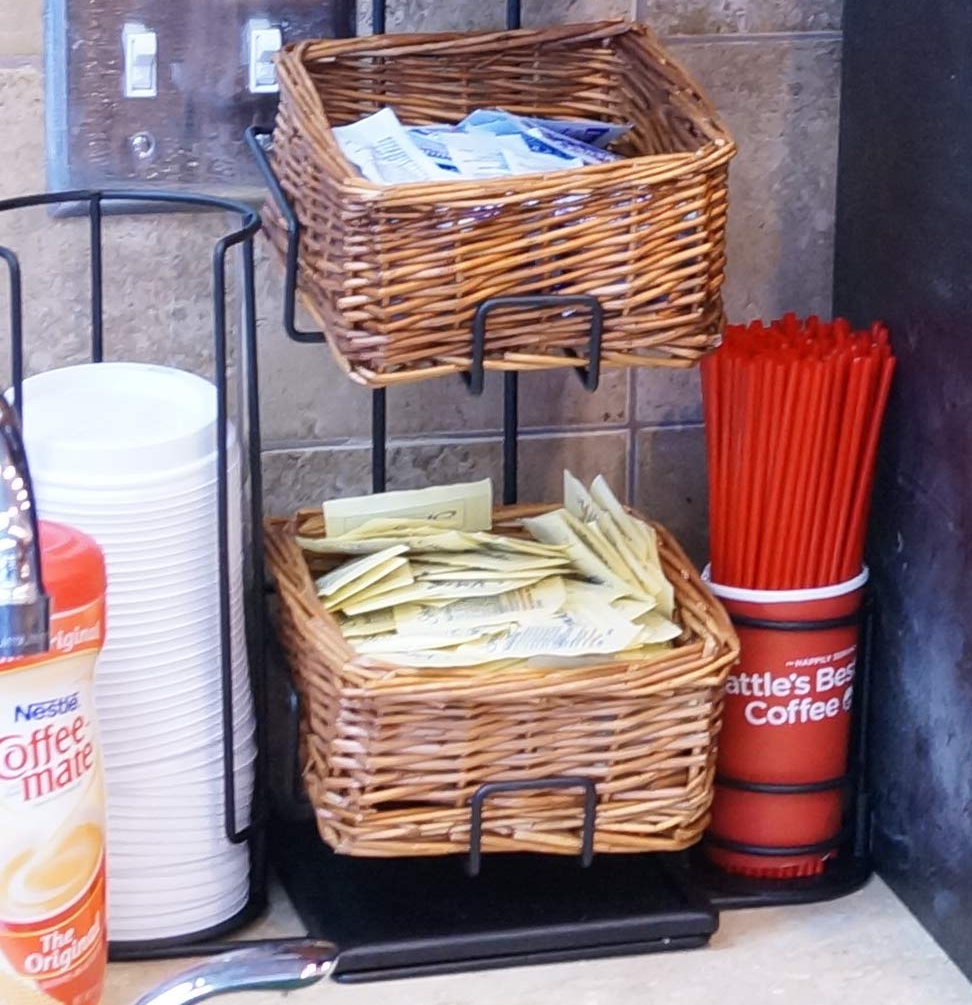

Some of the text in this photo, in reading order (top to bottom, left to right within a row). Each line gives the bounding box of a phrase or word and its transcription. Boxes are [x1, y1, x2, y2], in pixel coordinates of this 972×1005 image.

[725, 660, 857, 697] attle's Bes
[745, 697, 840, 725] Coffee
[22, 742, 93, 802] mate
[40, 927, 75, 953] The
